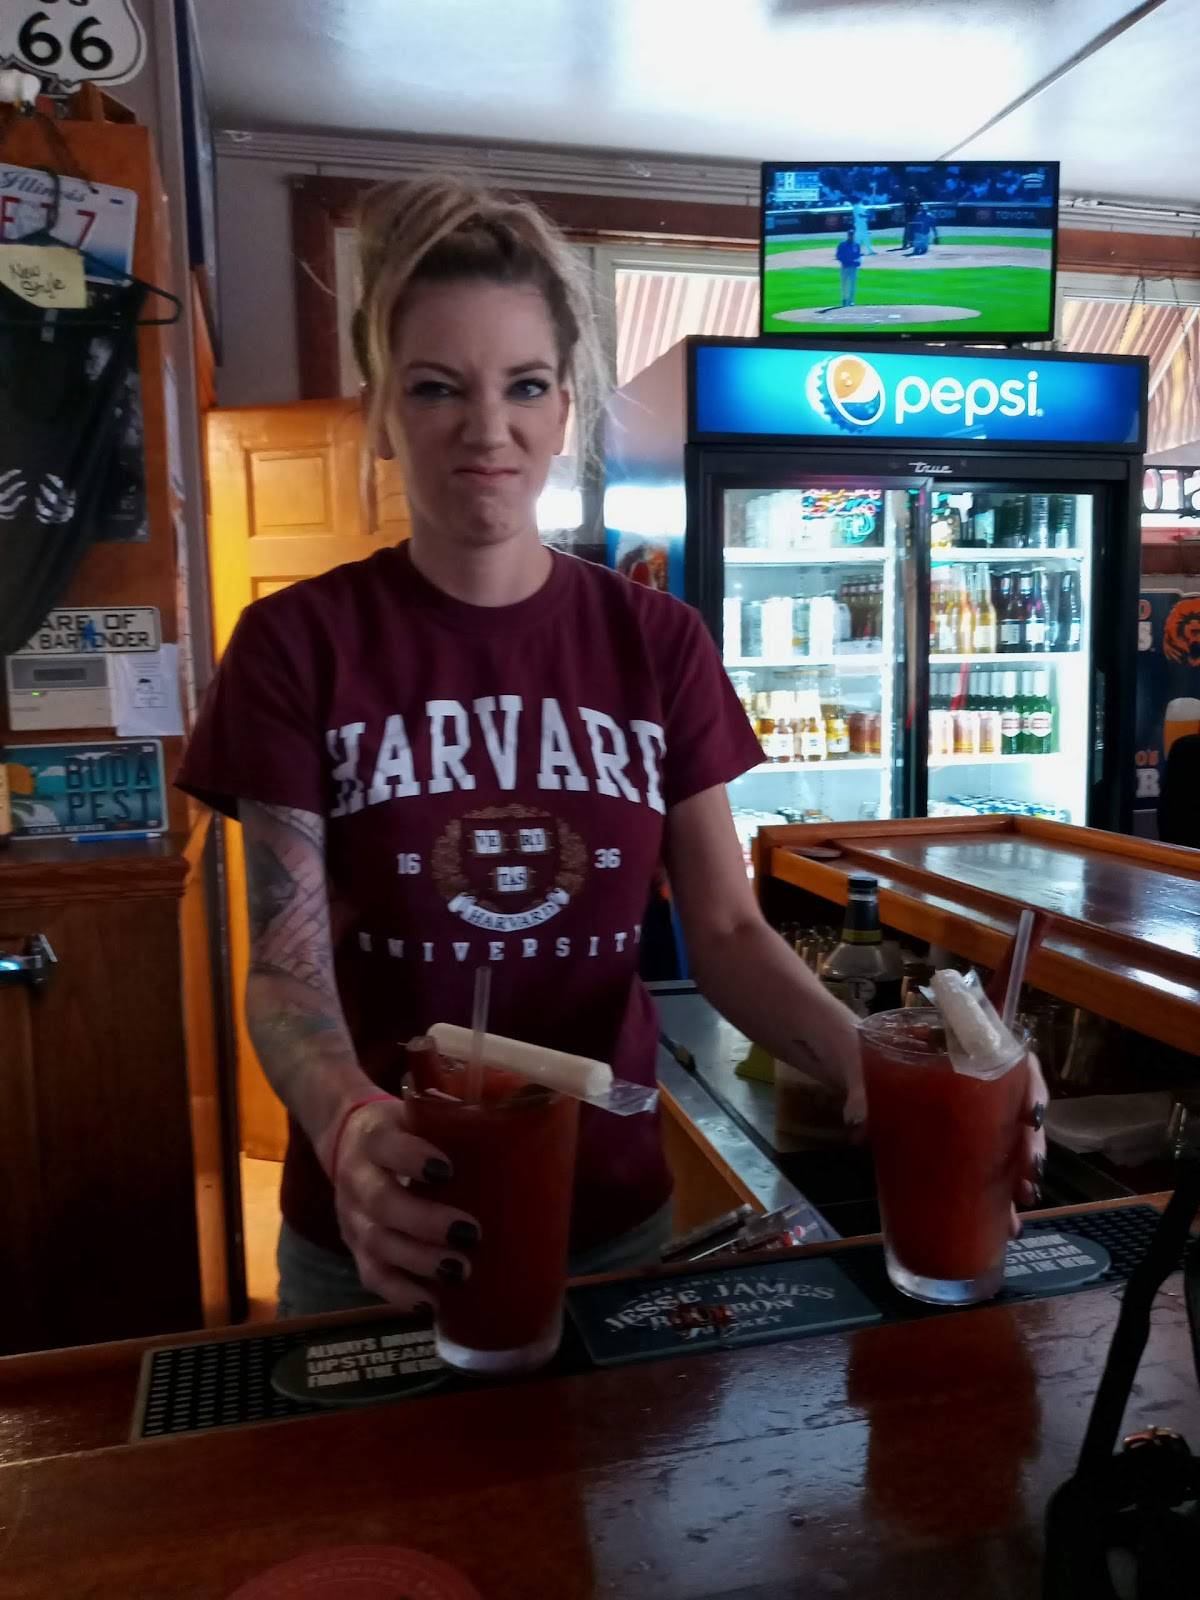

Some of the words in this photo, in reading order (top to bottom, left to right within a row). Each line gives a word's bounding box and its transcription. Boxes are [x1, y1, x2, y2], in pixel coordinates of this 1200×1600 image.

[19, 11, 112, 71] 66
[896, 370, 1038, 426] pepsi
[104, 614, 136, 630] OF
[68, 788, 153, 824] PEST
[397, 853, 421, 875] 16
[594, 848, 621, 869] 36
[1005, 1244, 1084, 1264] STREAM
[604, 1289, 703, 1333] JESSE
[712, 1281, 836, 1300] JAMES
